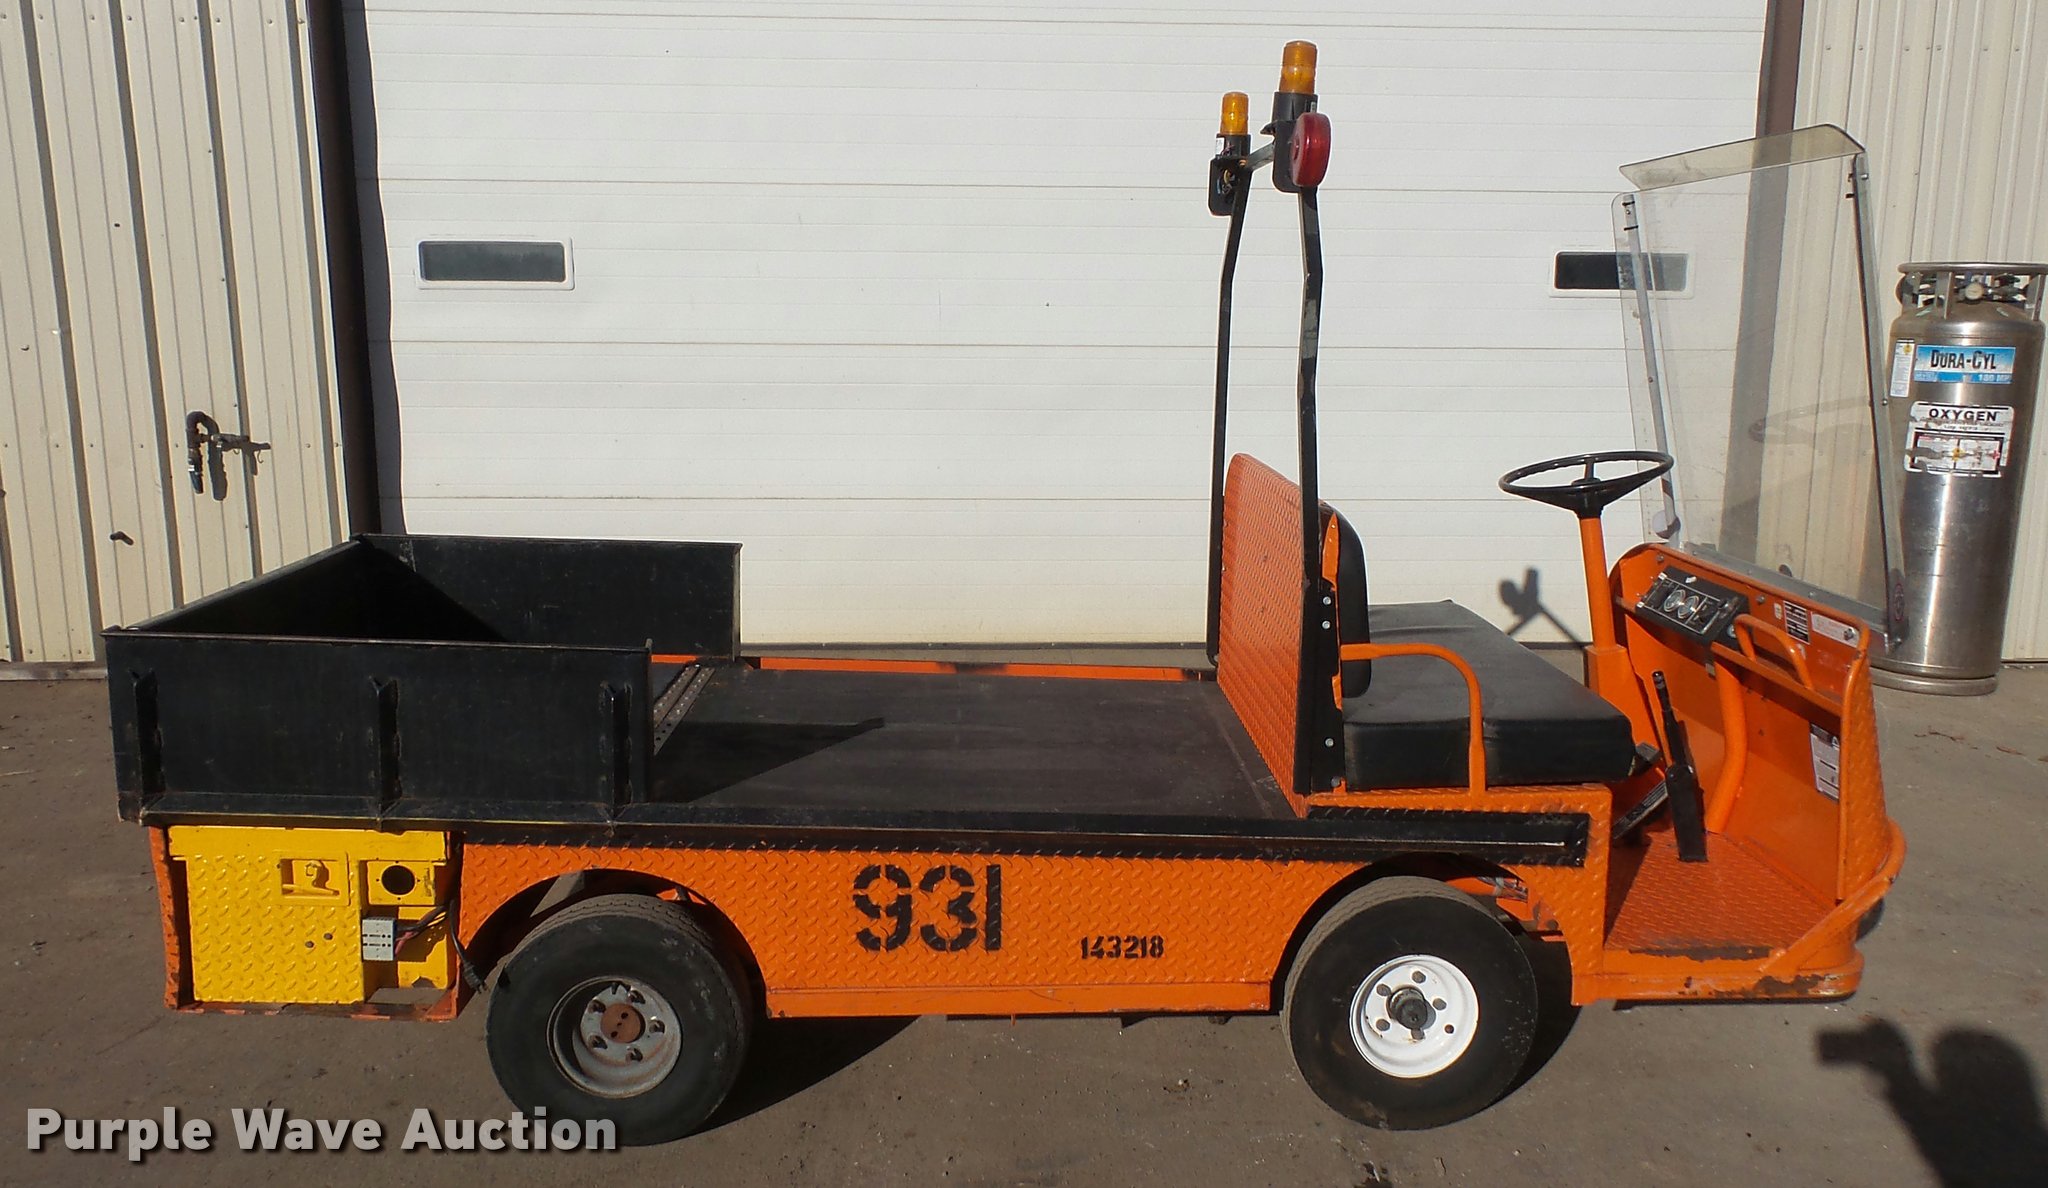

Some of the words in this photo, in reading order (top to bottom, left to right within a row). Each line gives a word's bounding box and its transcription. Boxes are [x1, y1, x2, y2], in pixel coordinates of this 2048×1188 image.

[1930, 349, 1997, 369] DURA-CYL
[1929, 408, 1997, 421] OXYGEN
[852, 863, 1002, 952] 931
[1080, 935, 1165, 960] 143218
